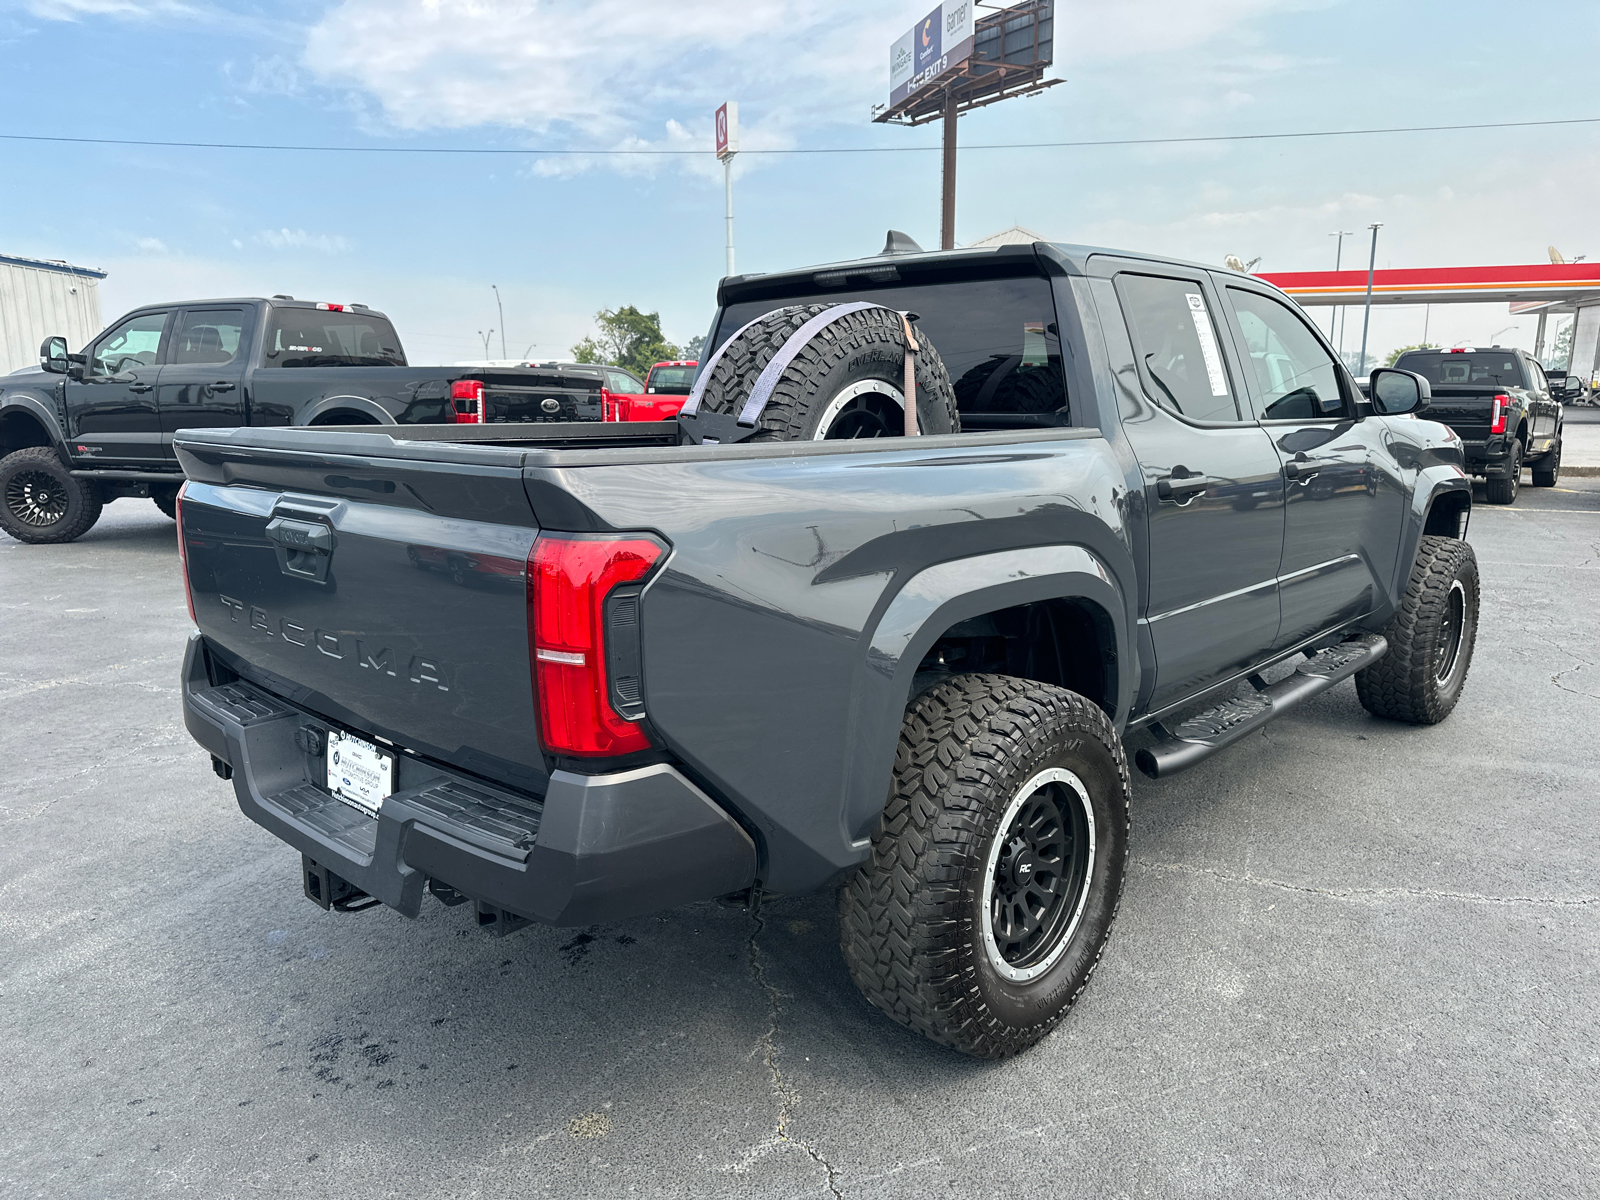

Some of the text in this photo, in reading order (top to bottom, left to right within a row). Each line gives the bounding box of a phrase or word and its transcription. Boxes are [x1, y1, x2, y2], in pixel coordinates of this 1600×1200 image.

[947, 2, 968, 32] Garner
[924, 58, 942, 82] EXIT
[942, 54, 948, 69] 9
[280, 529, 309, 545] TOYOTA
[220, 594, 449, 691] TACOMA
[1019, 863, 1032, 873] RC
